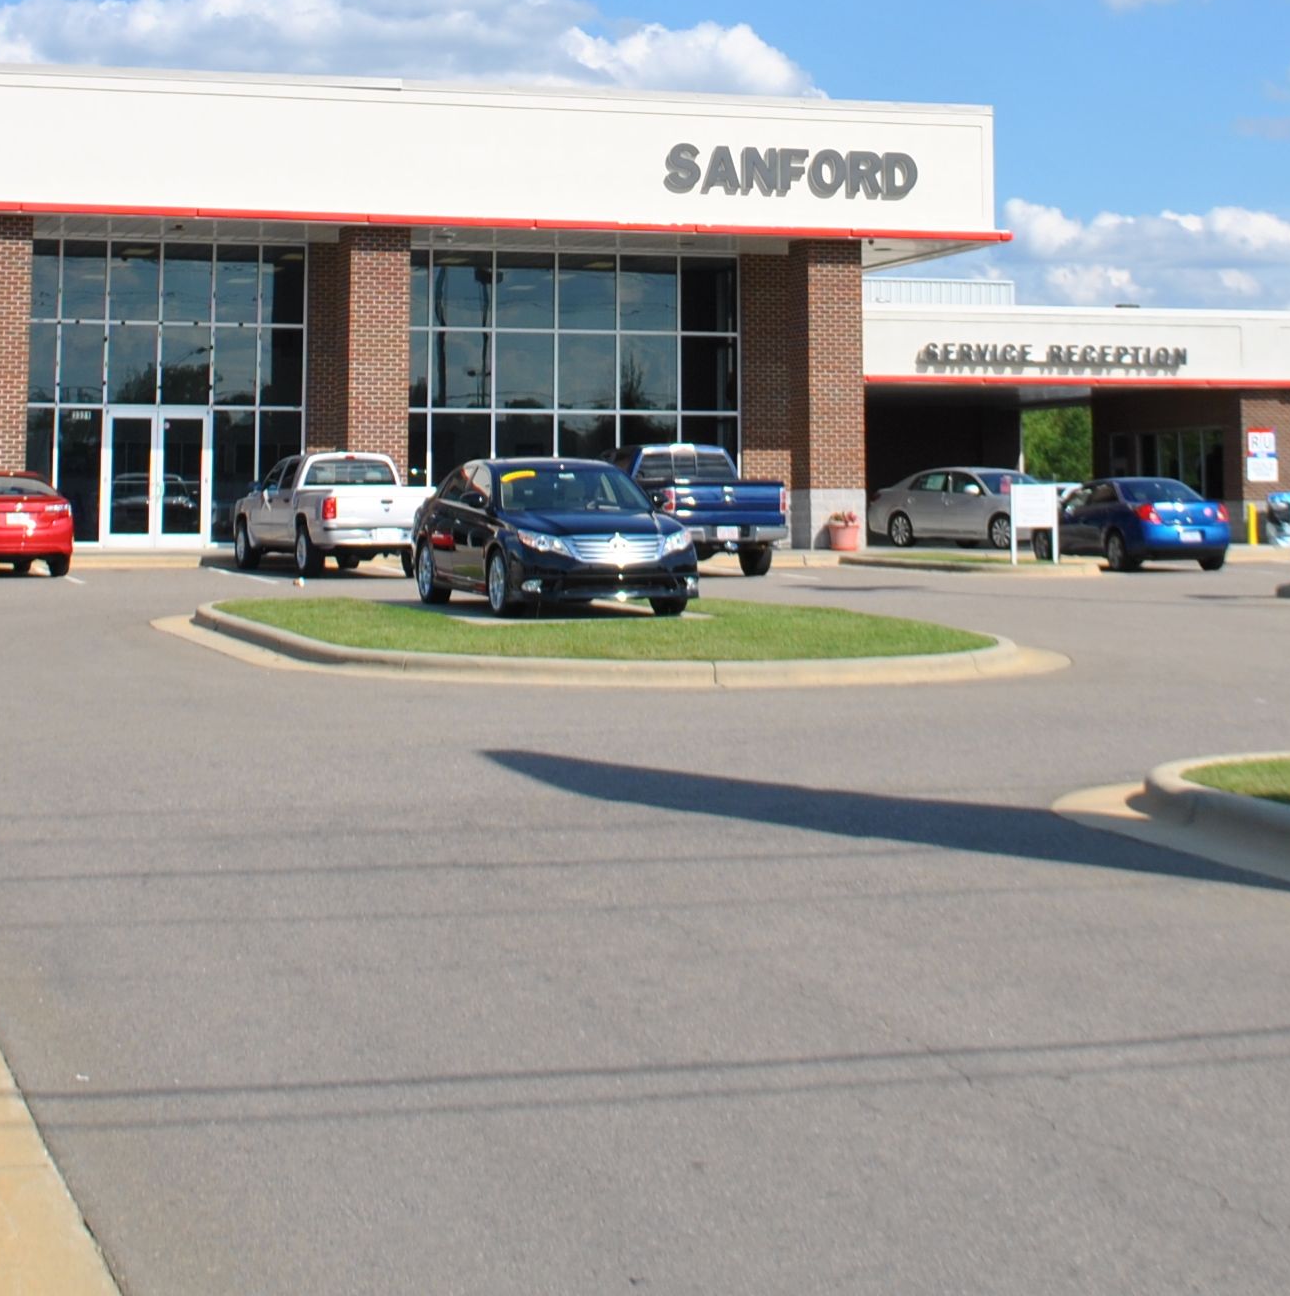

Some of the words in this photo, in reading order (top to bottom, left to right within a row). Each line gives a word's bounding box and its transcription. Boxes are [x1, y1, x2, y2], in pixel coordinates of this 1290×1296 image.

[664, 143, 919, 200] SANFORD
[919, 342, 1033, 368] SERVICE
[1047, 344, 1188, 370] RECEPTION
